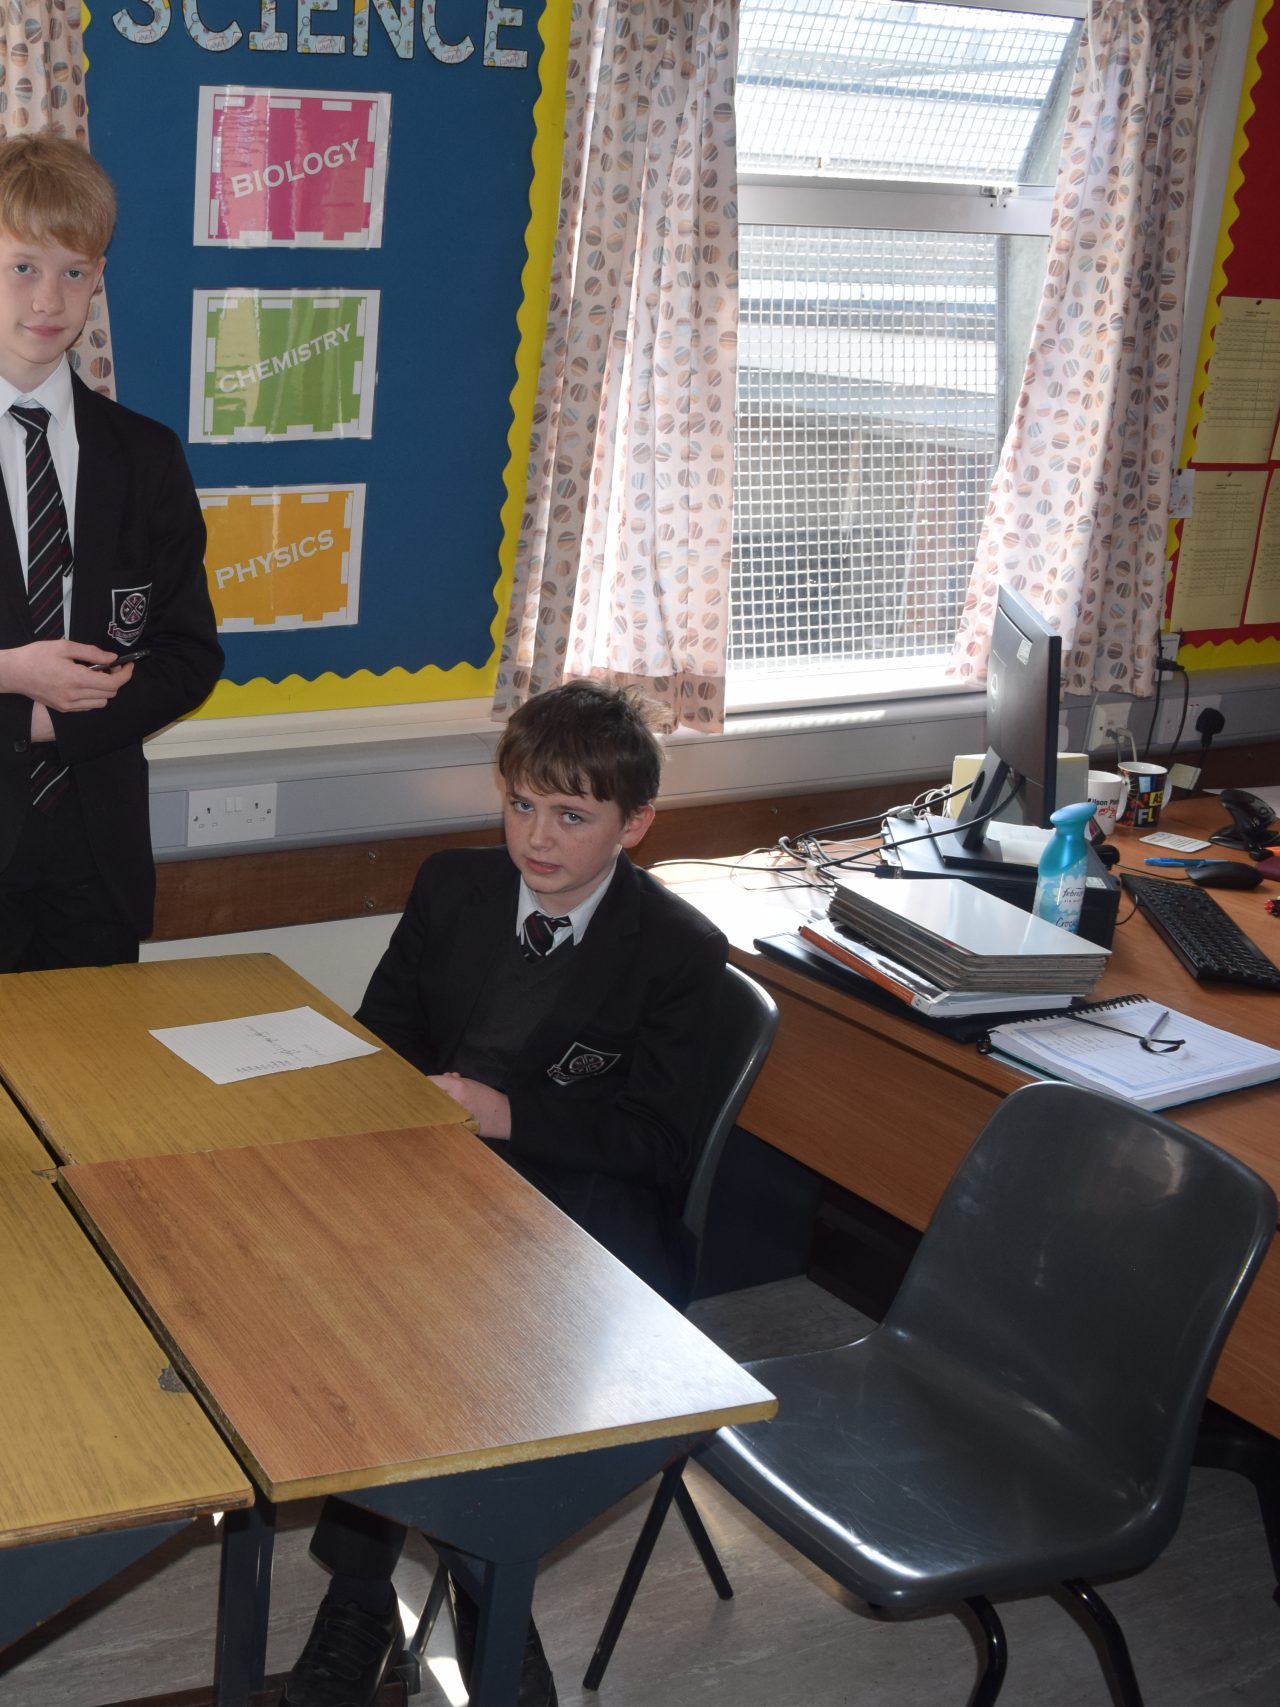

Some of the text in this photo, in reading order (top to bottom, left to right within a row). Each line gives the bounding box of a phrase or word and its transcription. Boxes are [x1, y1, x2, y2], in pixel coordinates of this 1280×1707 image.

[230, 137, 361, 200] BIOLOGY
[218, 322, 353, 394] CHEMISTRY
[214, 528, 335, 589] PHYSICS
